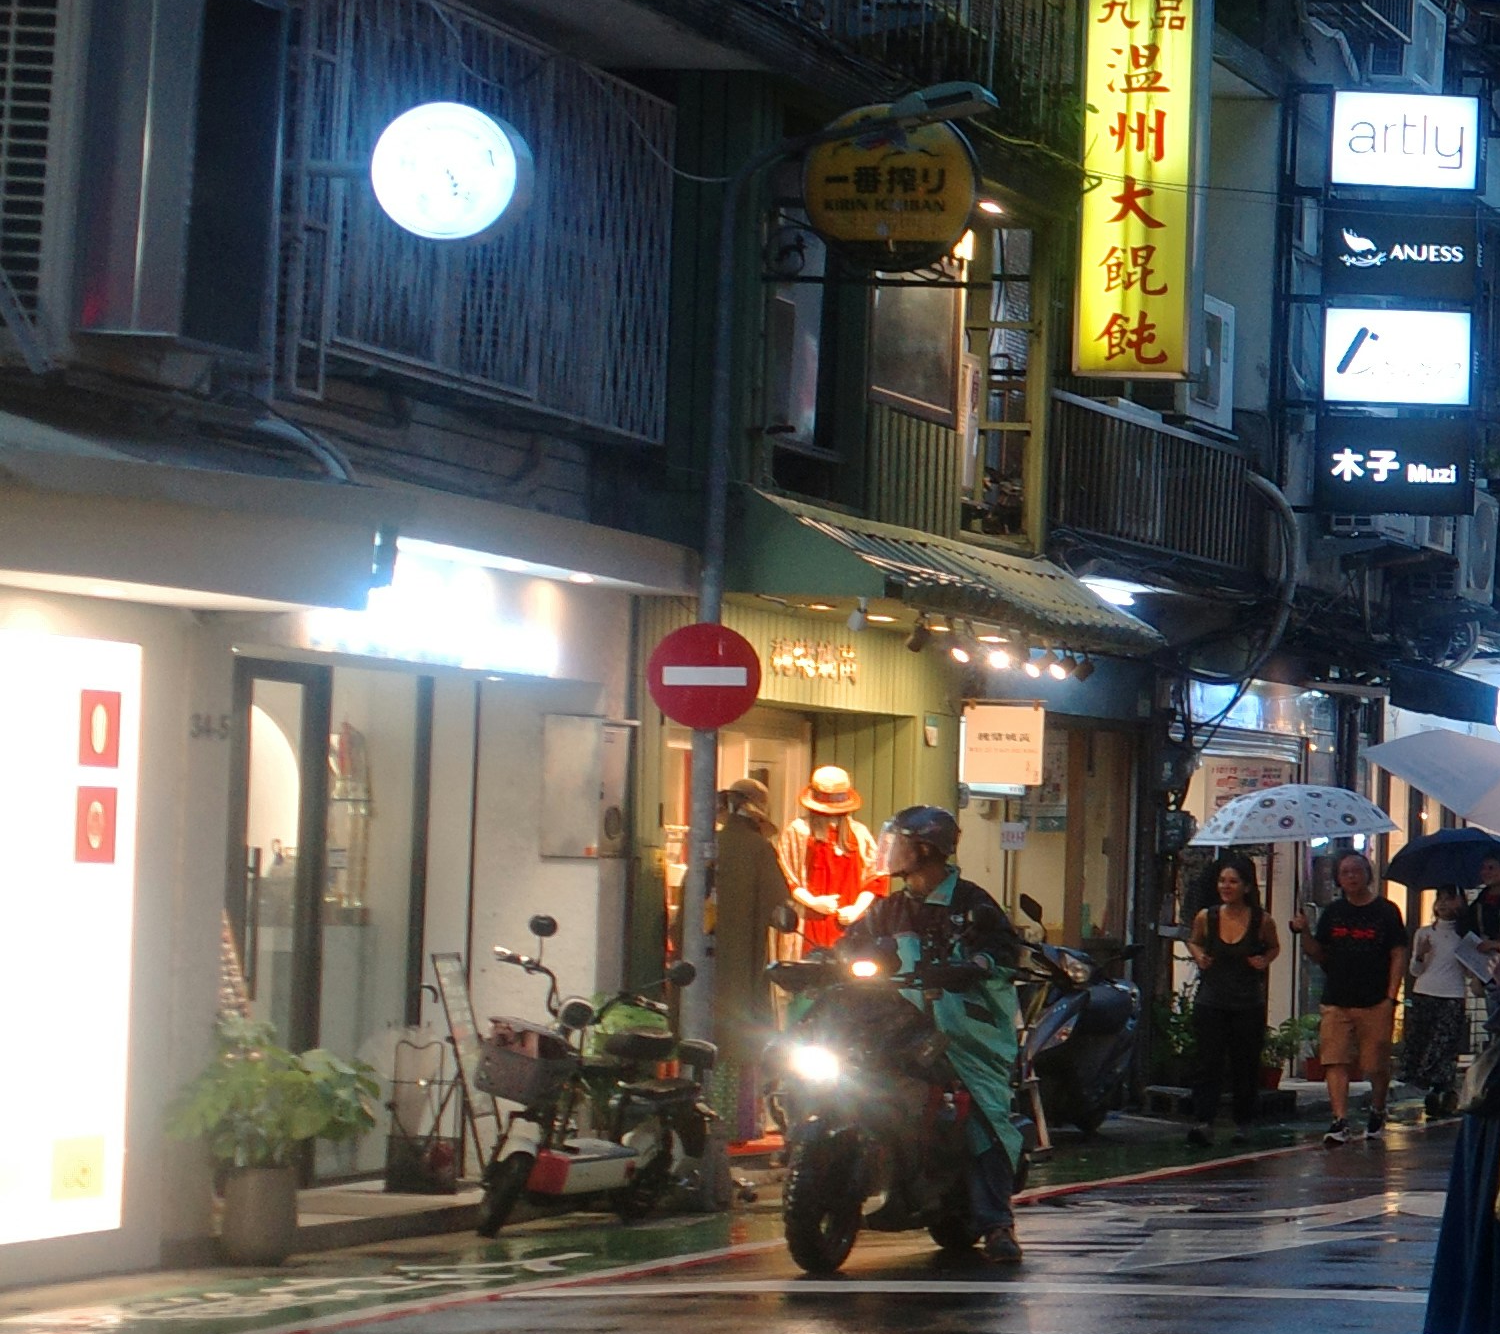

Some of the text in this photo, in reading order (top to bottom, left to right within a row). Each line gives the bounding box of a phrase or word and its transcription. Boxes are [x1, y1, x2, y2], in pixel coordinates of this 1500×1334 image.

[1348, 113, 1465, 169] artly
[824, 166, 945, 194] 一番搾り
[824, 198, 945, 213] KIRIN ICIBAN
[1390, 244, 1465, 265] ANJESS
[1331, 448, 1458, 485] 木子 Muzi
